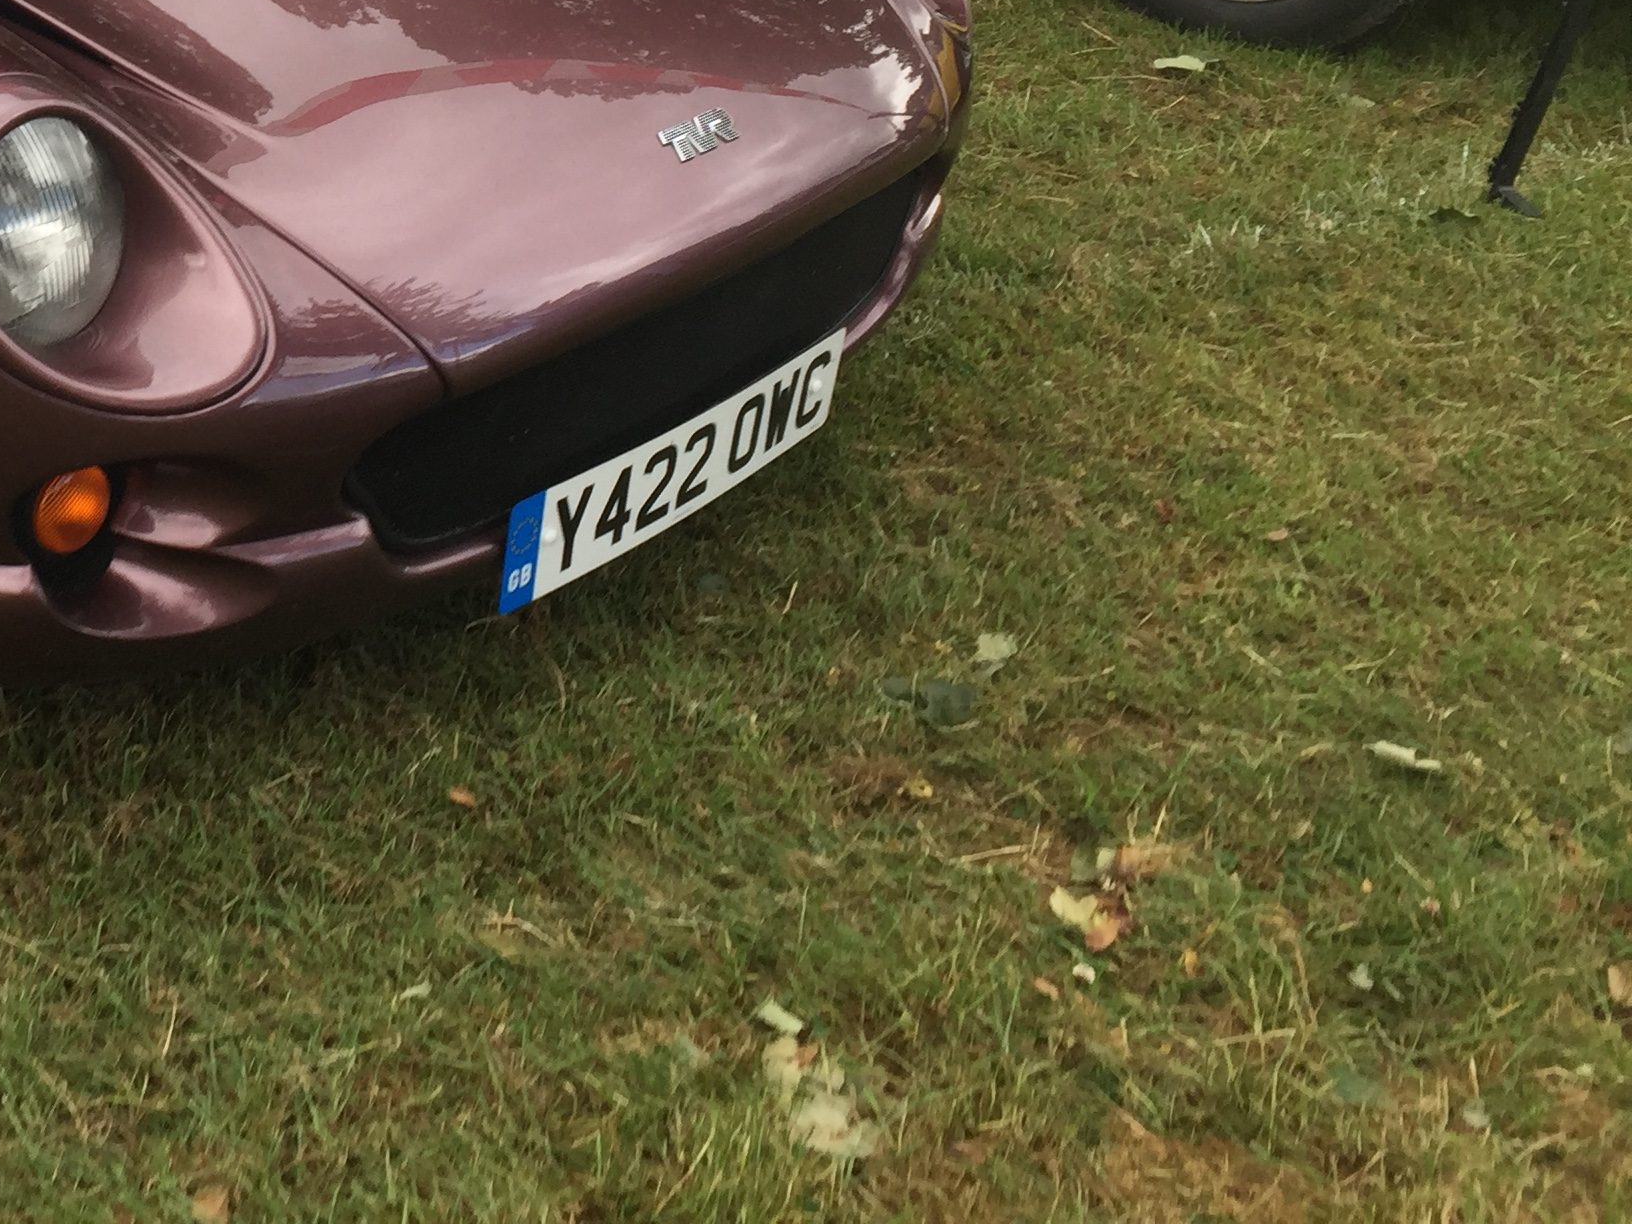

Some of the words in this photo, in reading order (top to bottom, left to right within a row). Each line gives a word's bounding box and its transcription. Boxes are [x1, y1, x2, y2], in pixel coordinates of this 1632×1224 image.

[657, 106, 742, 163] TVR
[556, 422, 718, 573] Y422
[727, 349, 833, 474] OWC
[506, 562, 533, 594] GB
